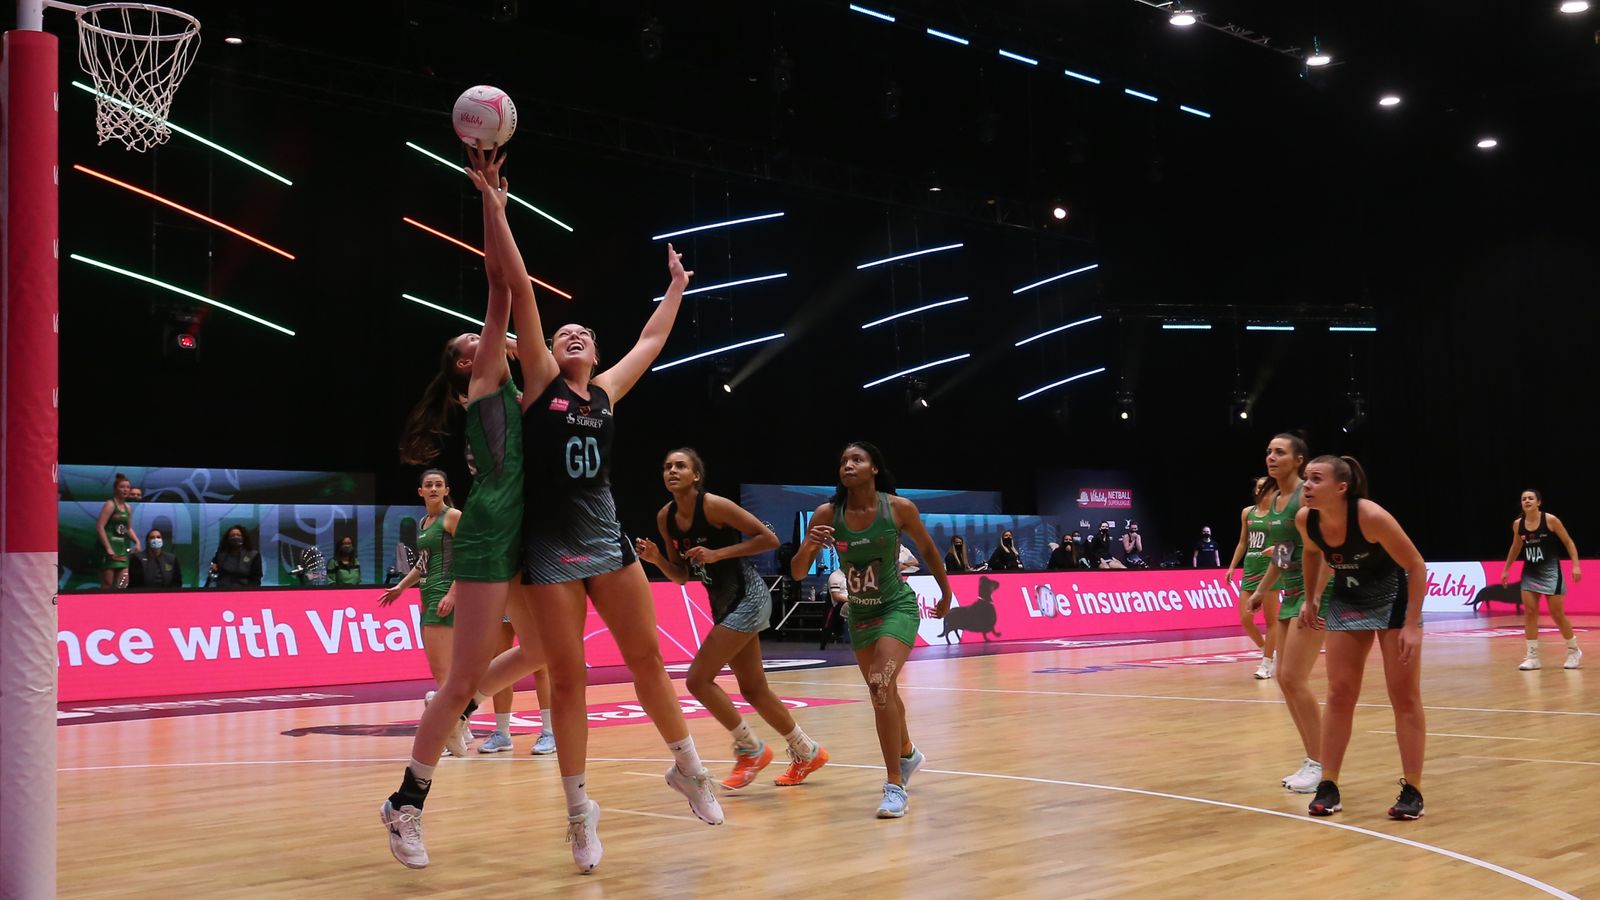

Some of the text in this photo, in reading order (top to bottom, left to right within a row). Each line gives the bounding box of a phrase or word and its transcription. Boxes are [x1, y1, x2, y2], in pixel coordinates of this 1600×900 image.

[576, 418, 603, 428] SURREY
[566, 436, 600, 478] GD
[1090, 490, 1131, 506] Vitality NETBALL
[1249, 532, 1265, 548] WD
[1526, 547, 1544, 563] WA
[848, 565, 878, 593] GA
[1425, 572, 1476, 605] tality
[1021, 584, 1072, 617] Le
[1072, 584, 1184, 615] insurance
[1184, 579, 1233, 610] with
[57, 604, 425, 667] nce with Vital
